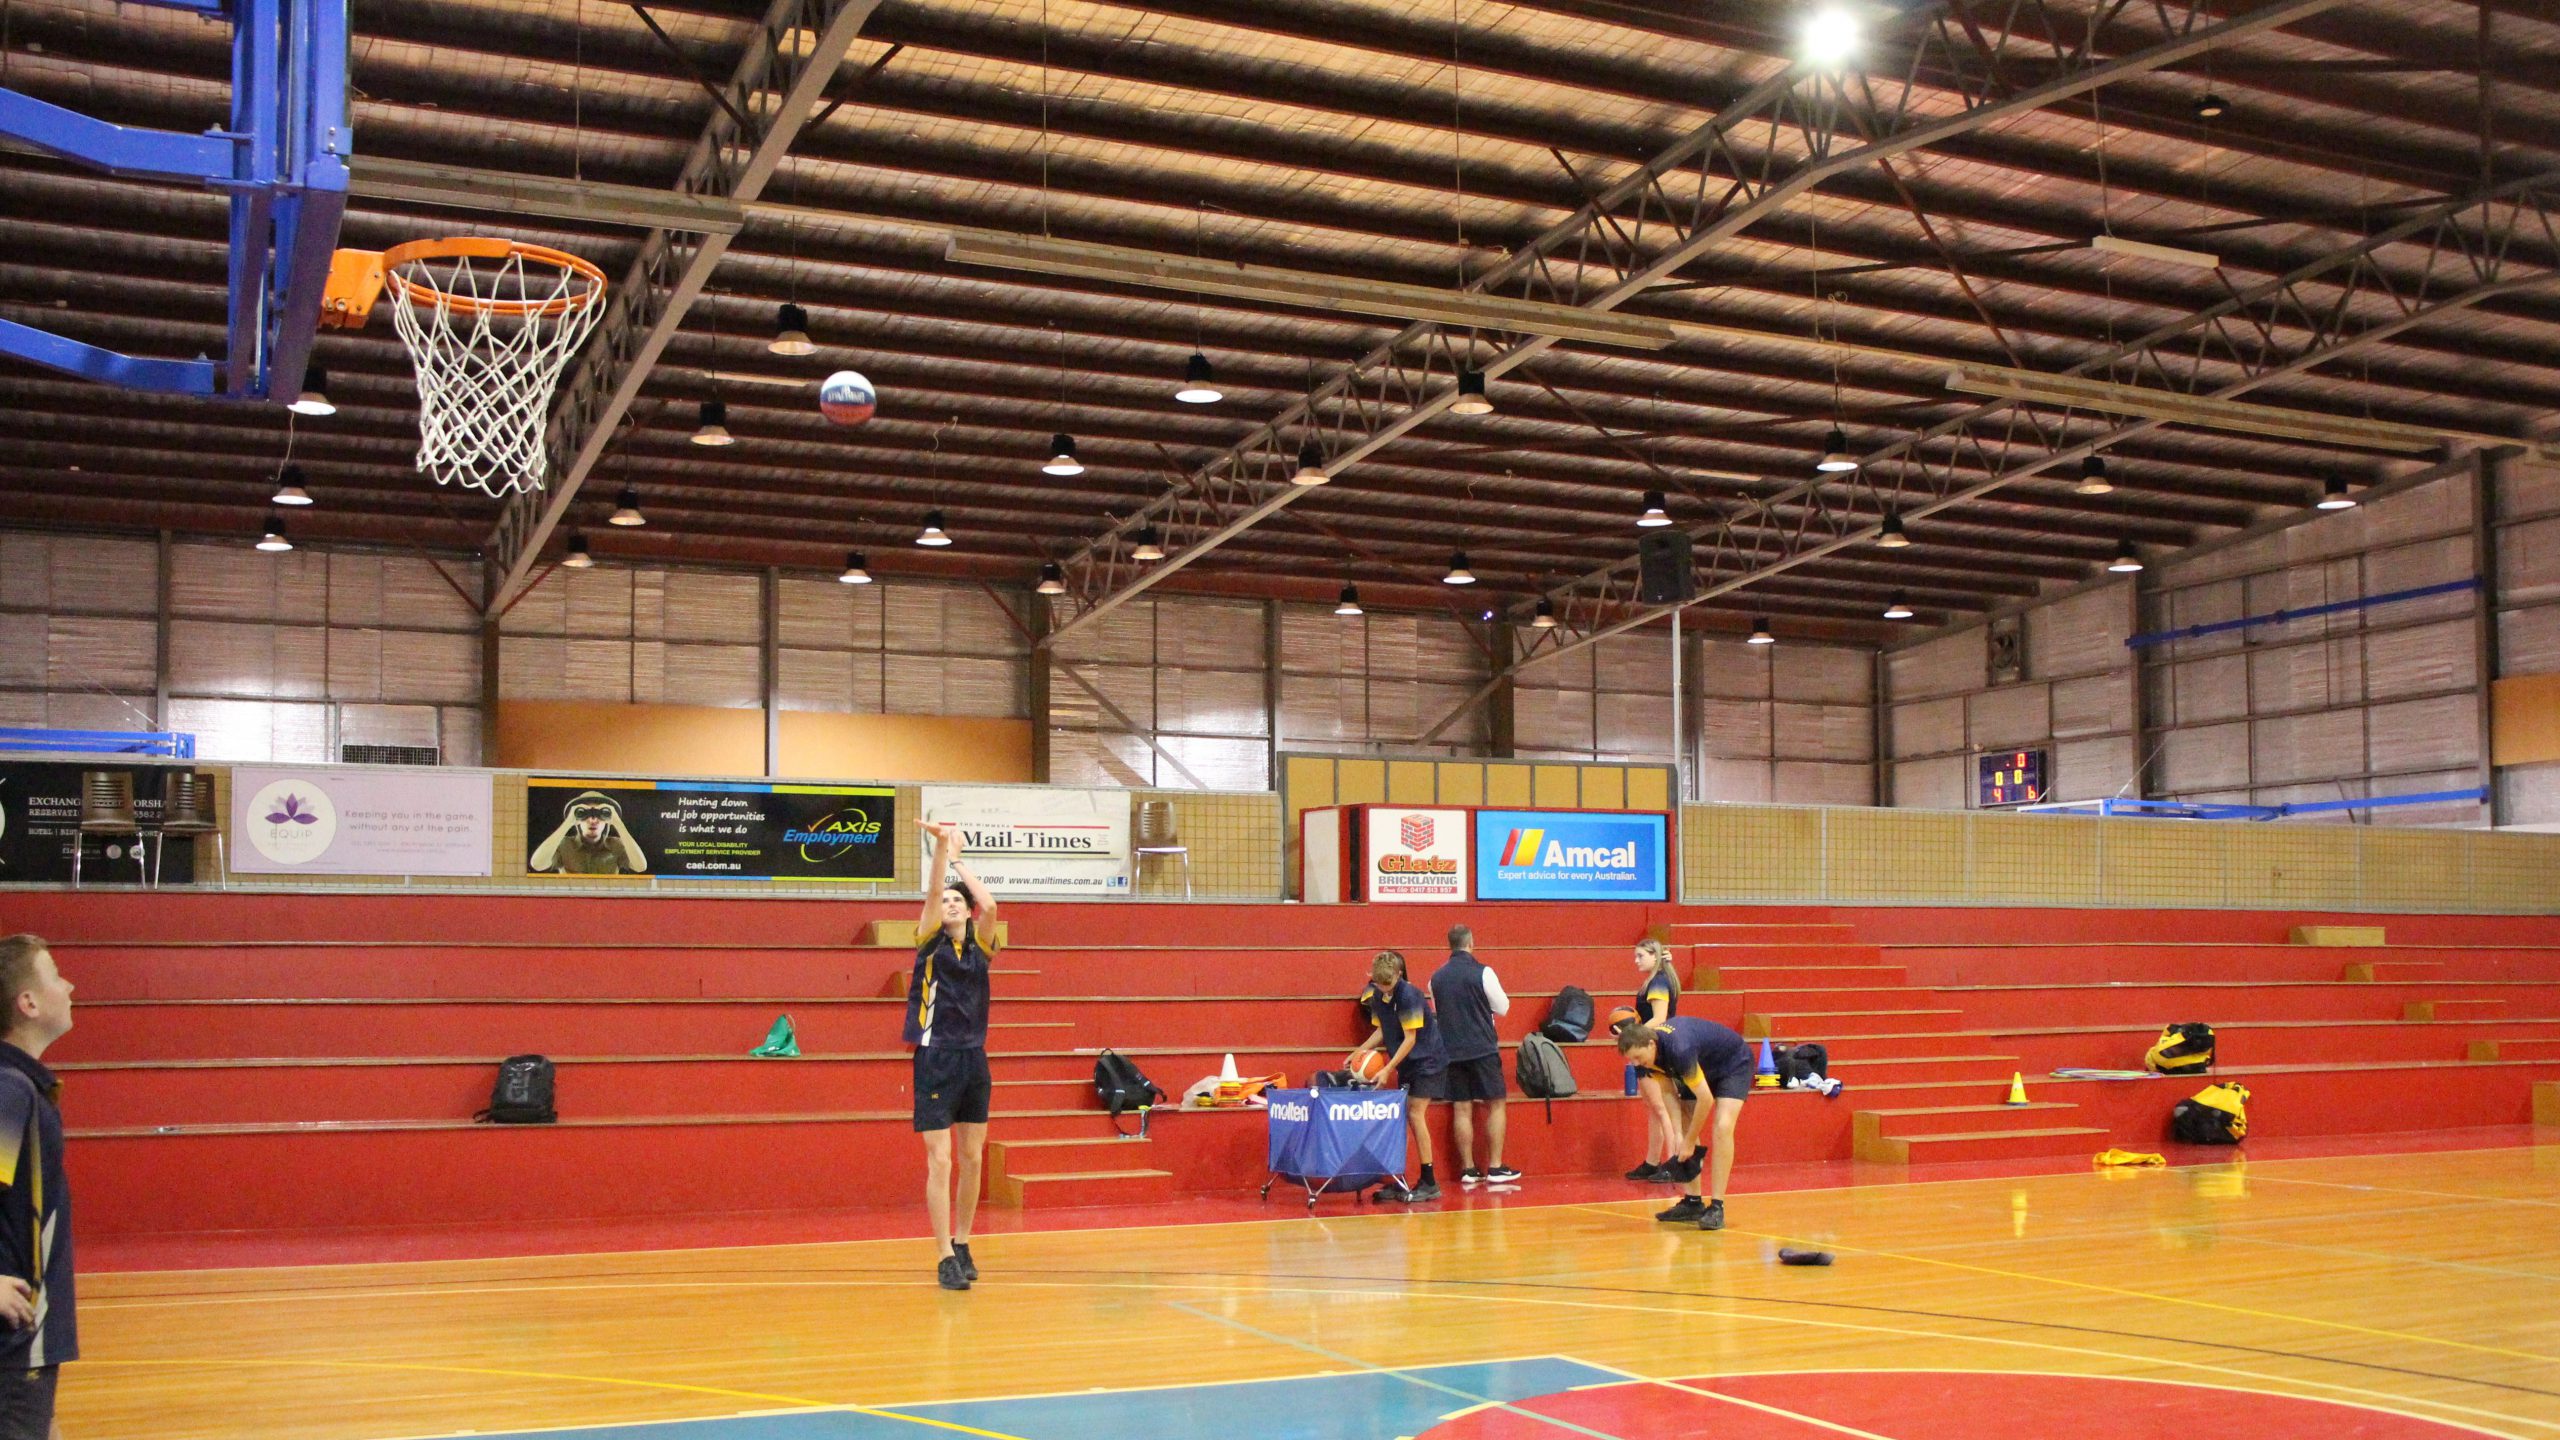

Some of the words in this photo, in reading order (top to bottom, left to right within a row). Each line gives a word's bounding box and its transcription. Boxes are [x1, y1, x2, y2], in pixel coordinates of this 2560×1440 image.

[28, 796, 80, 807] EXCHANG
[678, 797, 719, 809] Hunting
[721, 797, 748, 807] down
[28, 808, 79, 817] RESERVATI
[345, 810, 388, 820] Keeping
[391, 811, 410, 820] you
[413, 811, 422, 819] in
[426, 811, 442, 819] the
[661, 810, 680, 819] real
[681, 810, 698, 822] job
[700, 811, 766, 823] opportunities
[350, 823, 388, 832] without
[391, 824, 410, 833] any
[414, 823, 424, 832] of
[428, 824, 444, 833] the
[679, 823, 687, 833] is
[690, 824, 715, 834] what
[718, 826, 732, 834] we
[735, 824, 748, 834] do
[825, 821, 882, 834] AXIS
[783, 828, 880, 846] Employment
[961, 830, 1092, 848] Mail-Times
[1543, 840, 1636, 868] Amcal
[686, 861, 742, 870] caei.com.au
[1378, 854, 1457, 874] Glatz
[983, 876, 1005, 885] 0000
[1008, 876, 1103, 886] www.mailtimes.com.au
[1378, 875, 1458, 885] BRICKLAYING
[1498, 871, 1526, 881] Expert
[1528, 871, 1557, 880] advice
[1558, 871, 1570, 880] for
[1571, 872, 1593, 882] every
[1594, 871, 1637, 881] Australian.
[1270, 1102, 1309, 1122] molten
[1329, 1101, 1400, 1121] molten
